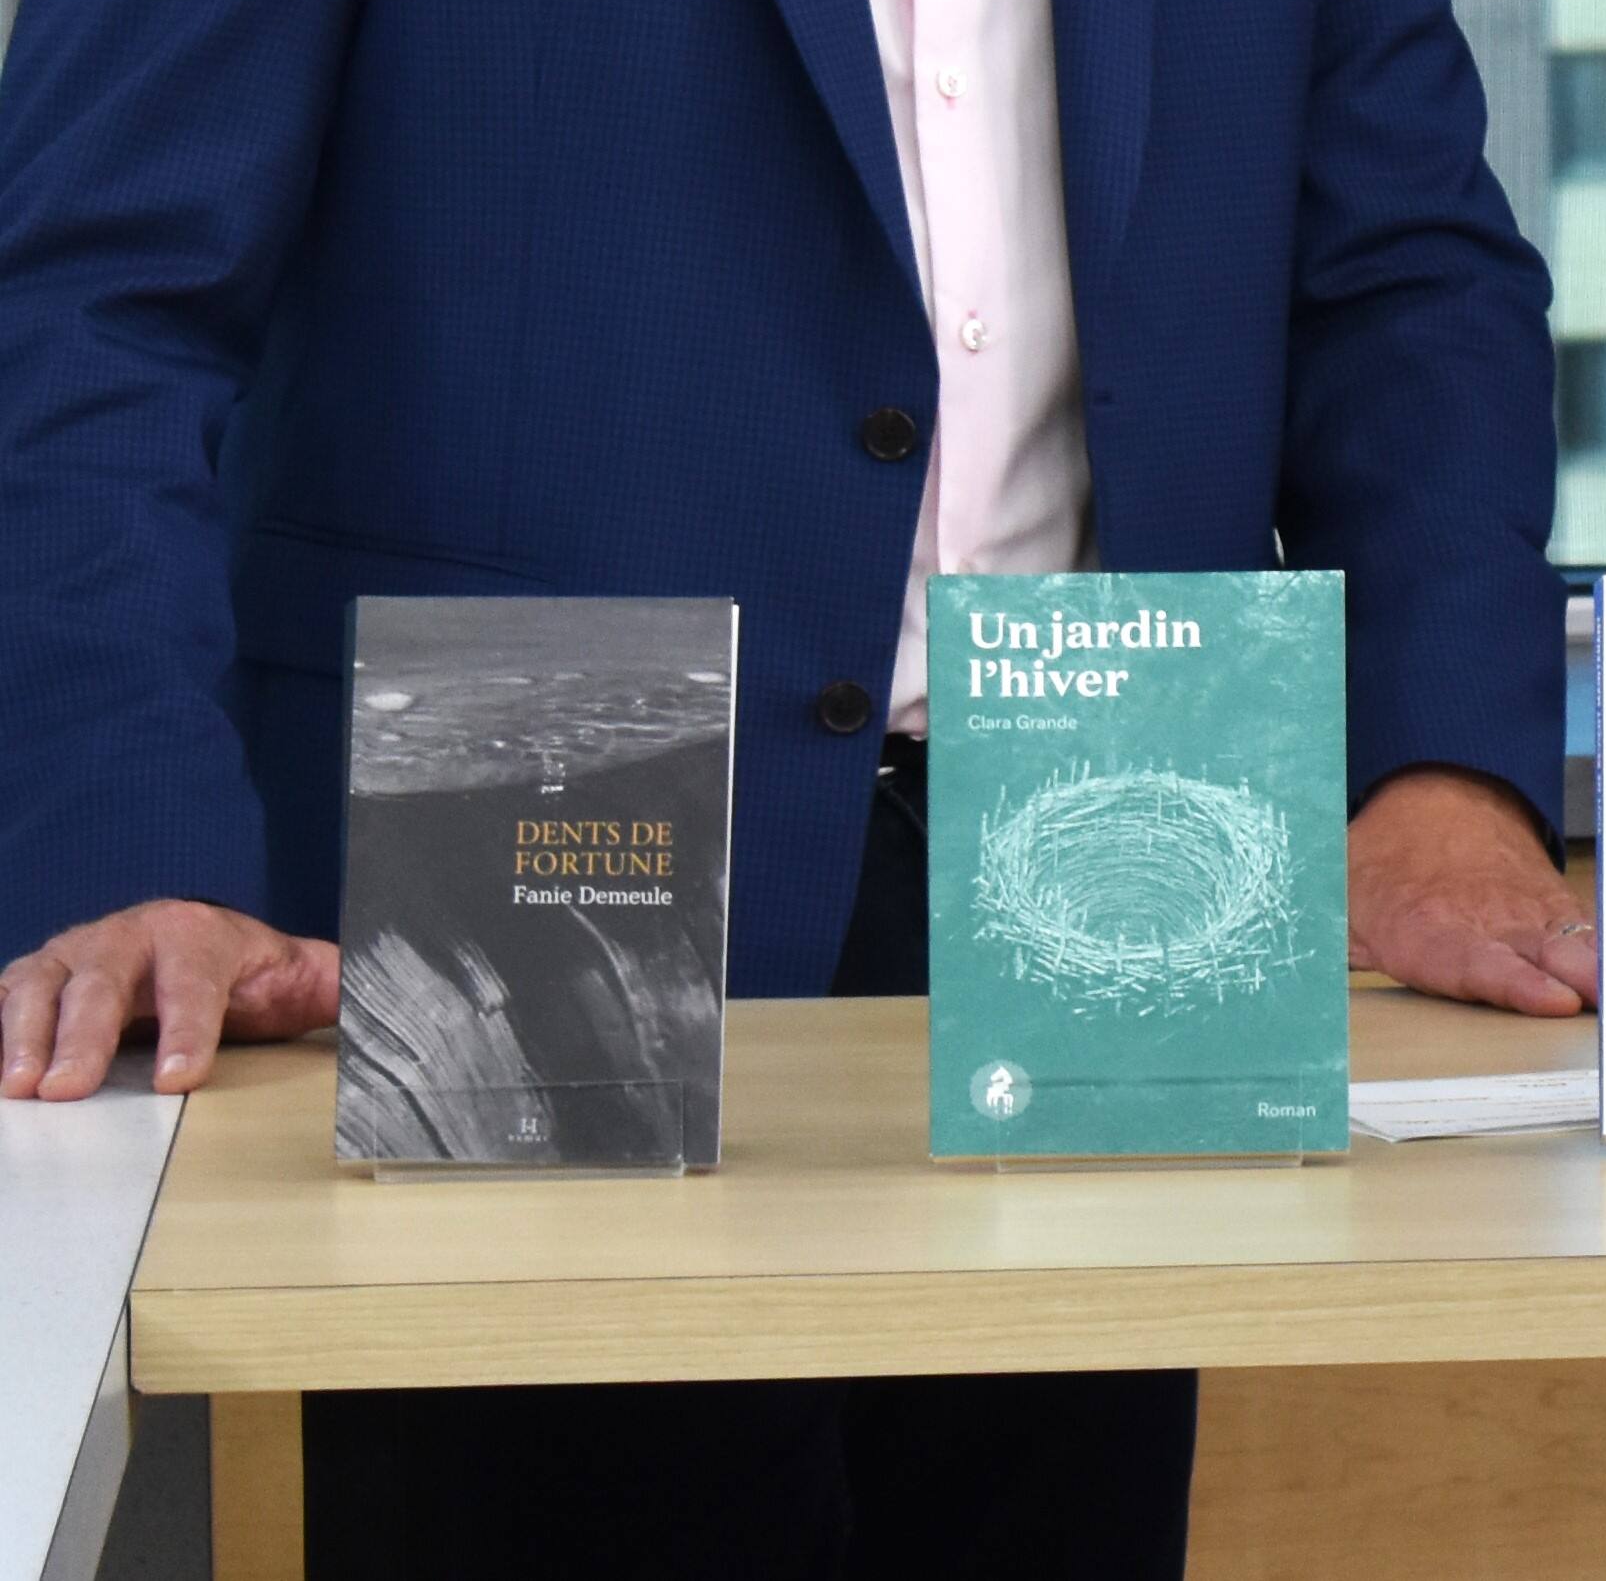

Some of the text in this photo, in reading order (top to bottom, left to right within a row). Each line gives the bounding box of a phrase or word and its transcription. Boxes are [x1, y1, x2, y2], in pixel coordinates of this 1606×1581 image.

[968, 609, 1202, 659] Un jardin
[968, 658, 1129, 698] l’hiver
[968, 714, 1078, 730] Clara Grande
[517, 821, 673, 845] DENTS DE
[515, 851, 673, 876] FORTUNE
[513, 885, 673, 905] Fanie Demeule
[1257, 1102, 1316, 1118] Roman
